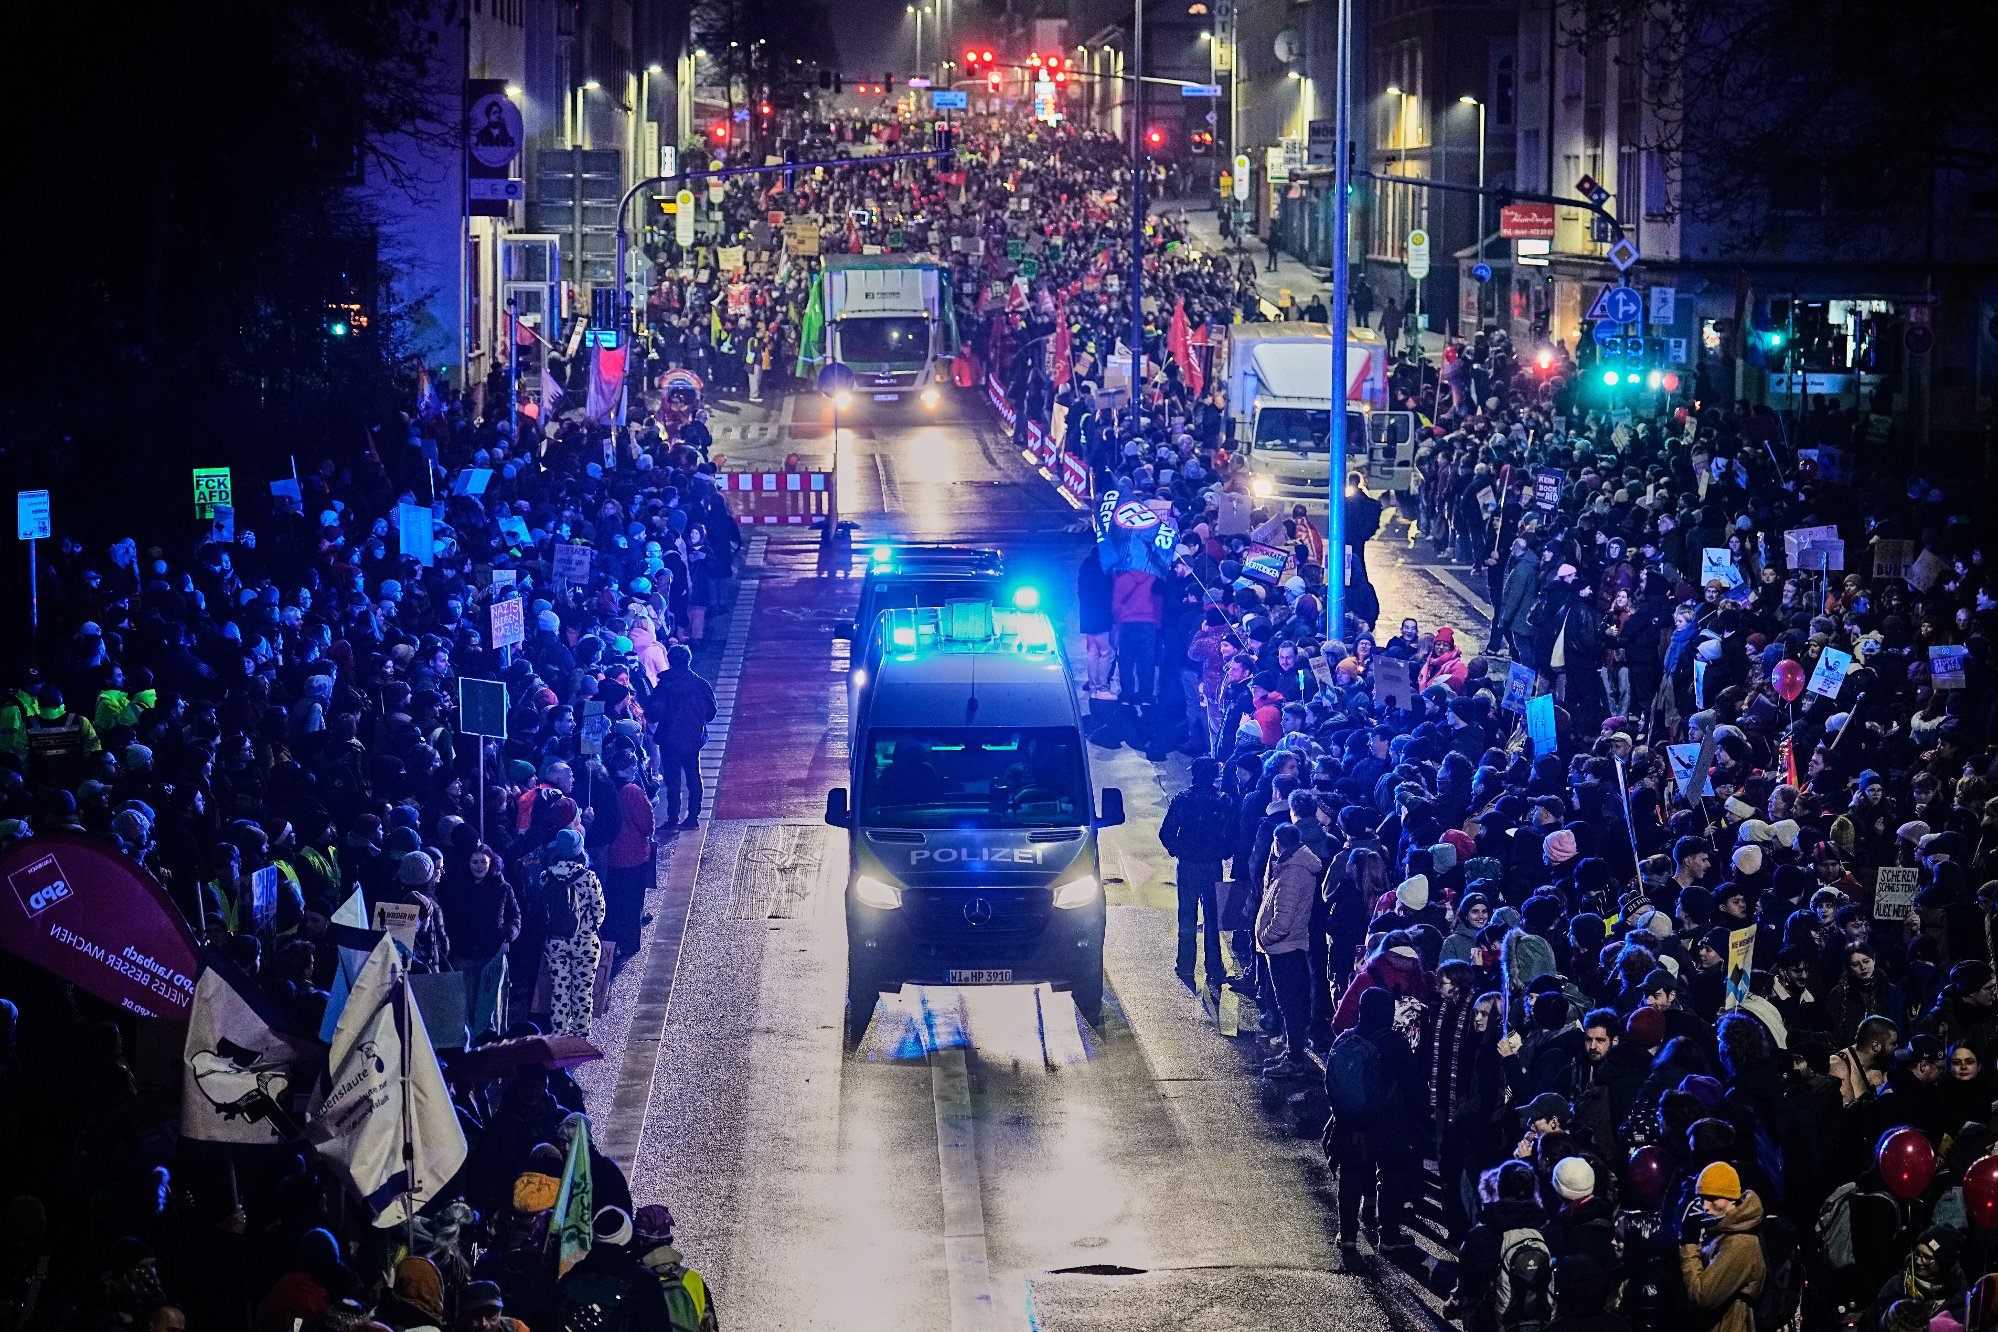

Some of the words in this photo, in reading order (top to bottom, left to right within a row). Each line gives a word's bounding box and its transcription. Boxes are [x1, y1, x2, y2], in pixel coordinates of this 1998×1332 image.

[195, 478, 228, 490] FCK
[1538, 476, 1556, 485] KEIN
[1538, 484, 1558, 493] BOCK
[196, 490, 230, 503] AFD
[1933, 656, 1959, 667] STOPPT
[1934, 664, 1947, 674] DIE
[910, 848, 1043, 865] POLIZEI
[1881, 869, 1918, 883] SCHEREN
[1877, 882, 1915, 893] SCHWESTERN
[950, 971, 963, 982] WI
[971, 971, 984, 982] HP
[986, 971, 1011, 982] 3910
